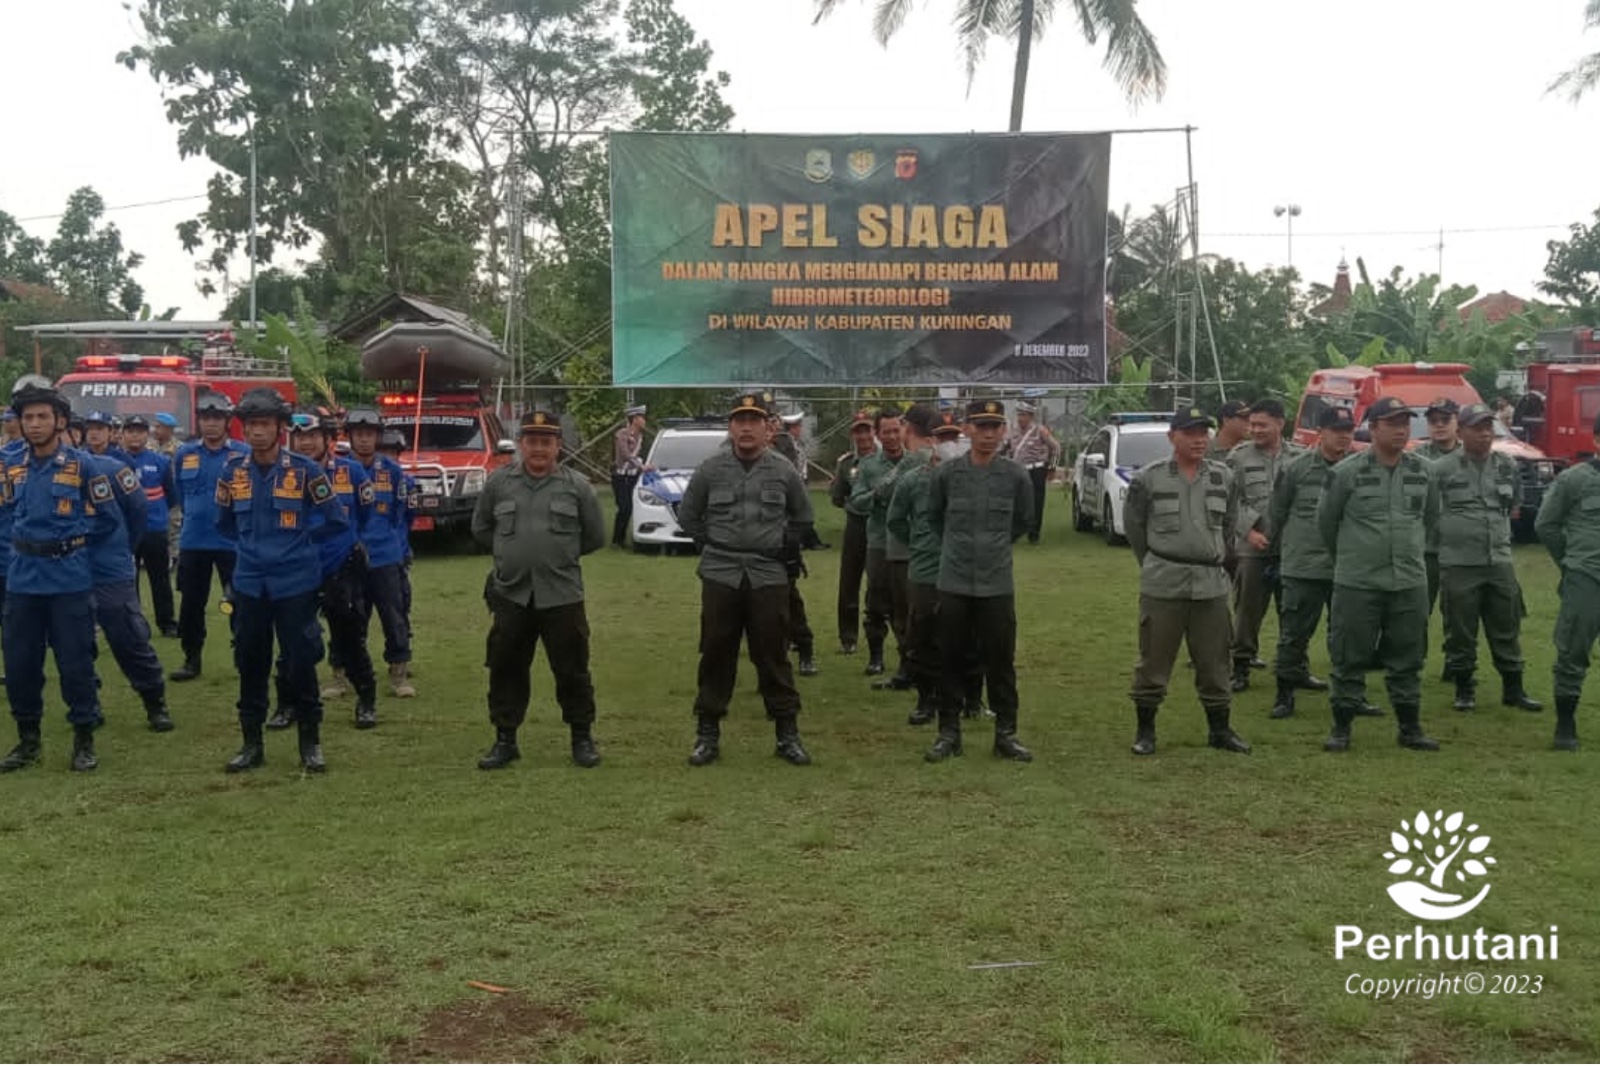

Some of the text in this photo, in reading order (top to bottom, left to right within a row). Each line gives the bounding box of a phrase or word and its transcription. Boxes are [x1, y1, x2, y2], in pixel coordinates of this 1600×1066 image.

[712, 203, 1008, 249] APEL SIAGA
[662, 261, 1059, 282] DALAM RANGKA MENGHADAPI BENCANA ALAM
[772, 287, 950, 306] HIDROMETEOROLOGI
[709, 315, 1012, 330] DI WILAYAH KABUPATEN KUNINGAN
[81, 383, 165, 397] PEMADAM
